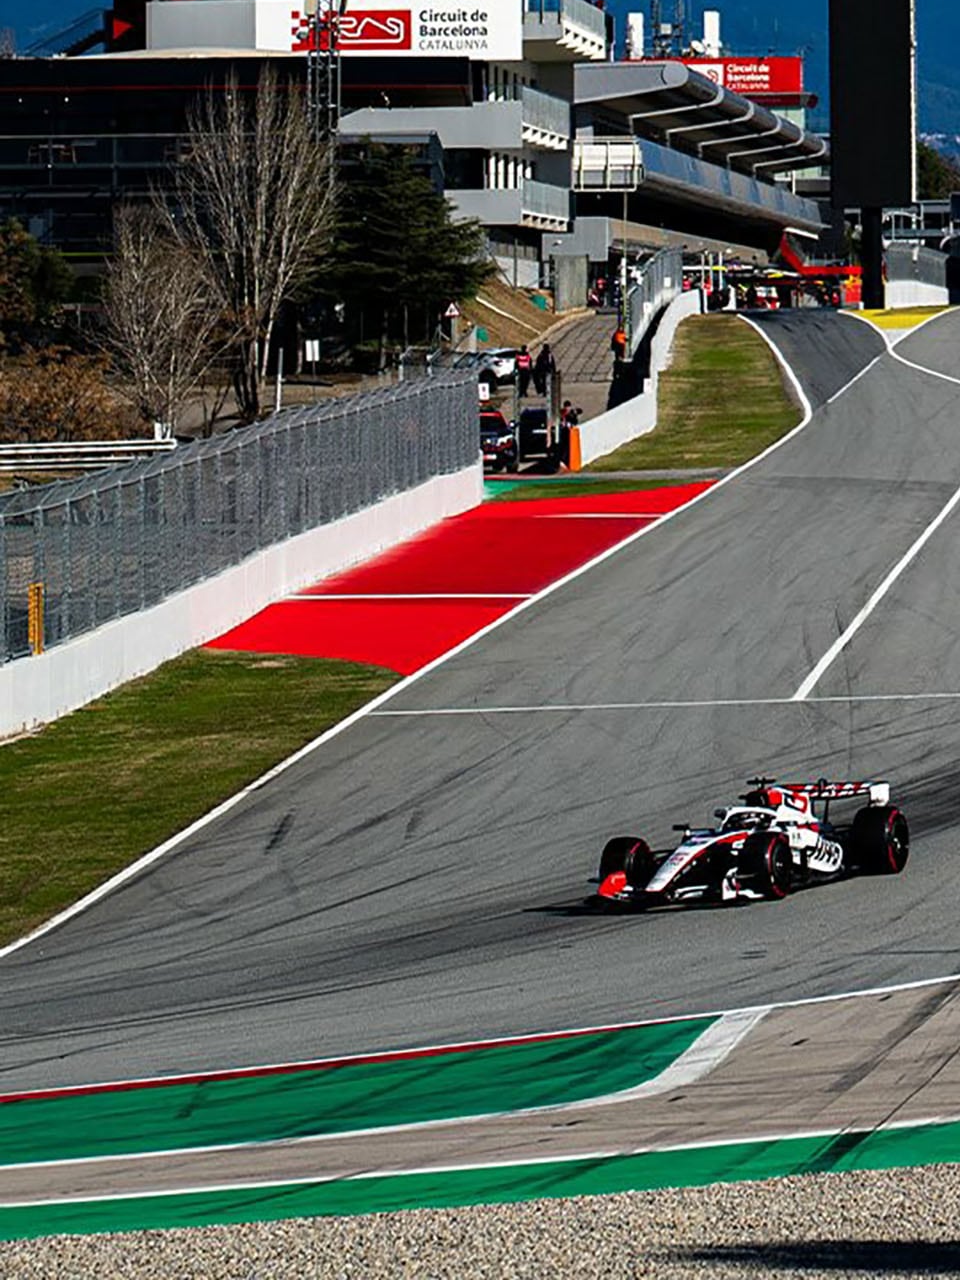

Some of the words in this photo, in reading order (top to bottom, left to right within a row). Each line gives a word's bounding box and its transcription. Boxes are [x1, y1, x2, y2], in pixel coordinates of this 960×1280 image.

[419, 9, 468, 22] Circuit
[470, 9, 488, 22] de
[419, 24, 488, 37] Barcelona
[419, 39, 488, 51] CATALUNYA
[727, 63, 757, 72] Circuit
[758, 63, 770, 72] de
